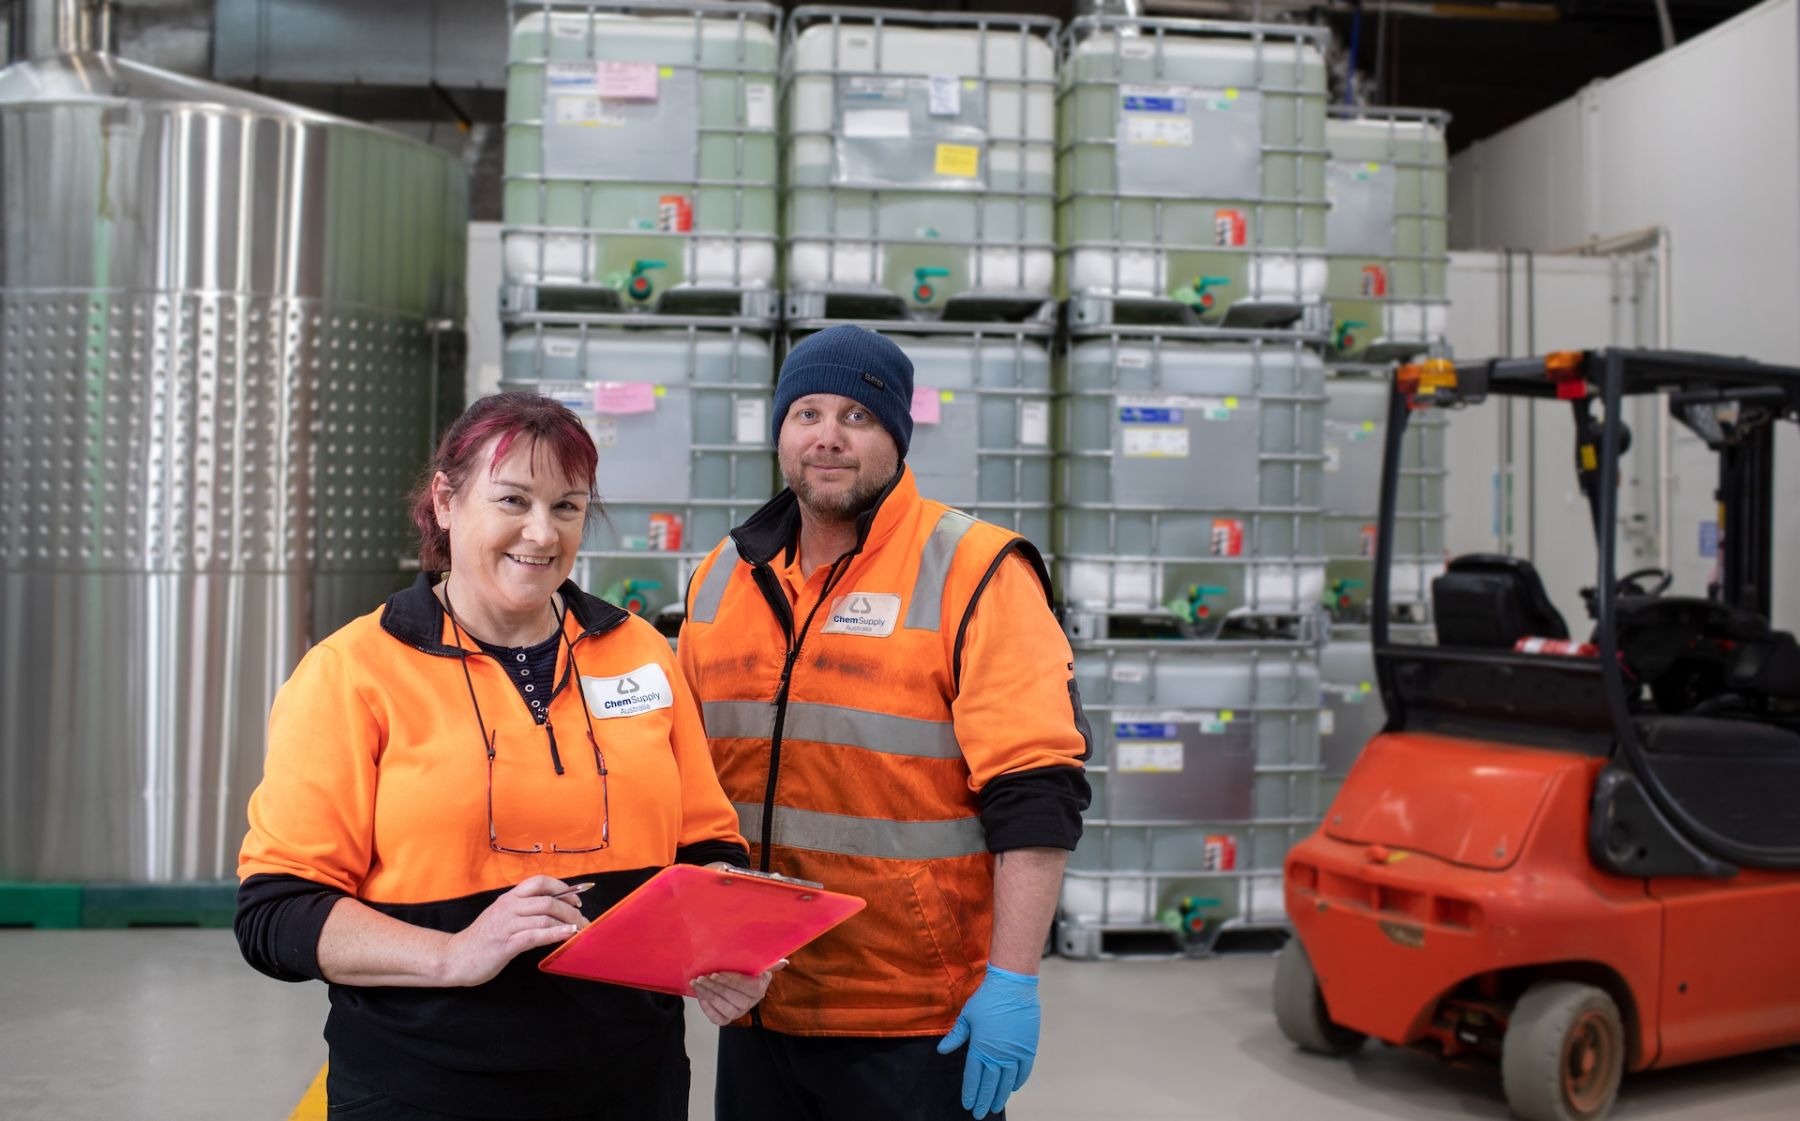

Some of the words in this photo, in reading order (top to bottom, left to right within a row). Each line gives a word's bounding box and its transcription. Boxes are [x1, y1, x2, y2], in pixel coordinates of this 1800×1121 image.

[833, 615, 885, 627] ChemSupply
[604, 692, 660, 709] ChemSupply
[620, 704, 651, 714] Australia
